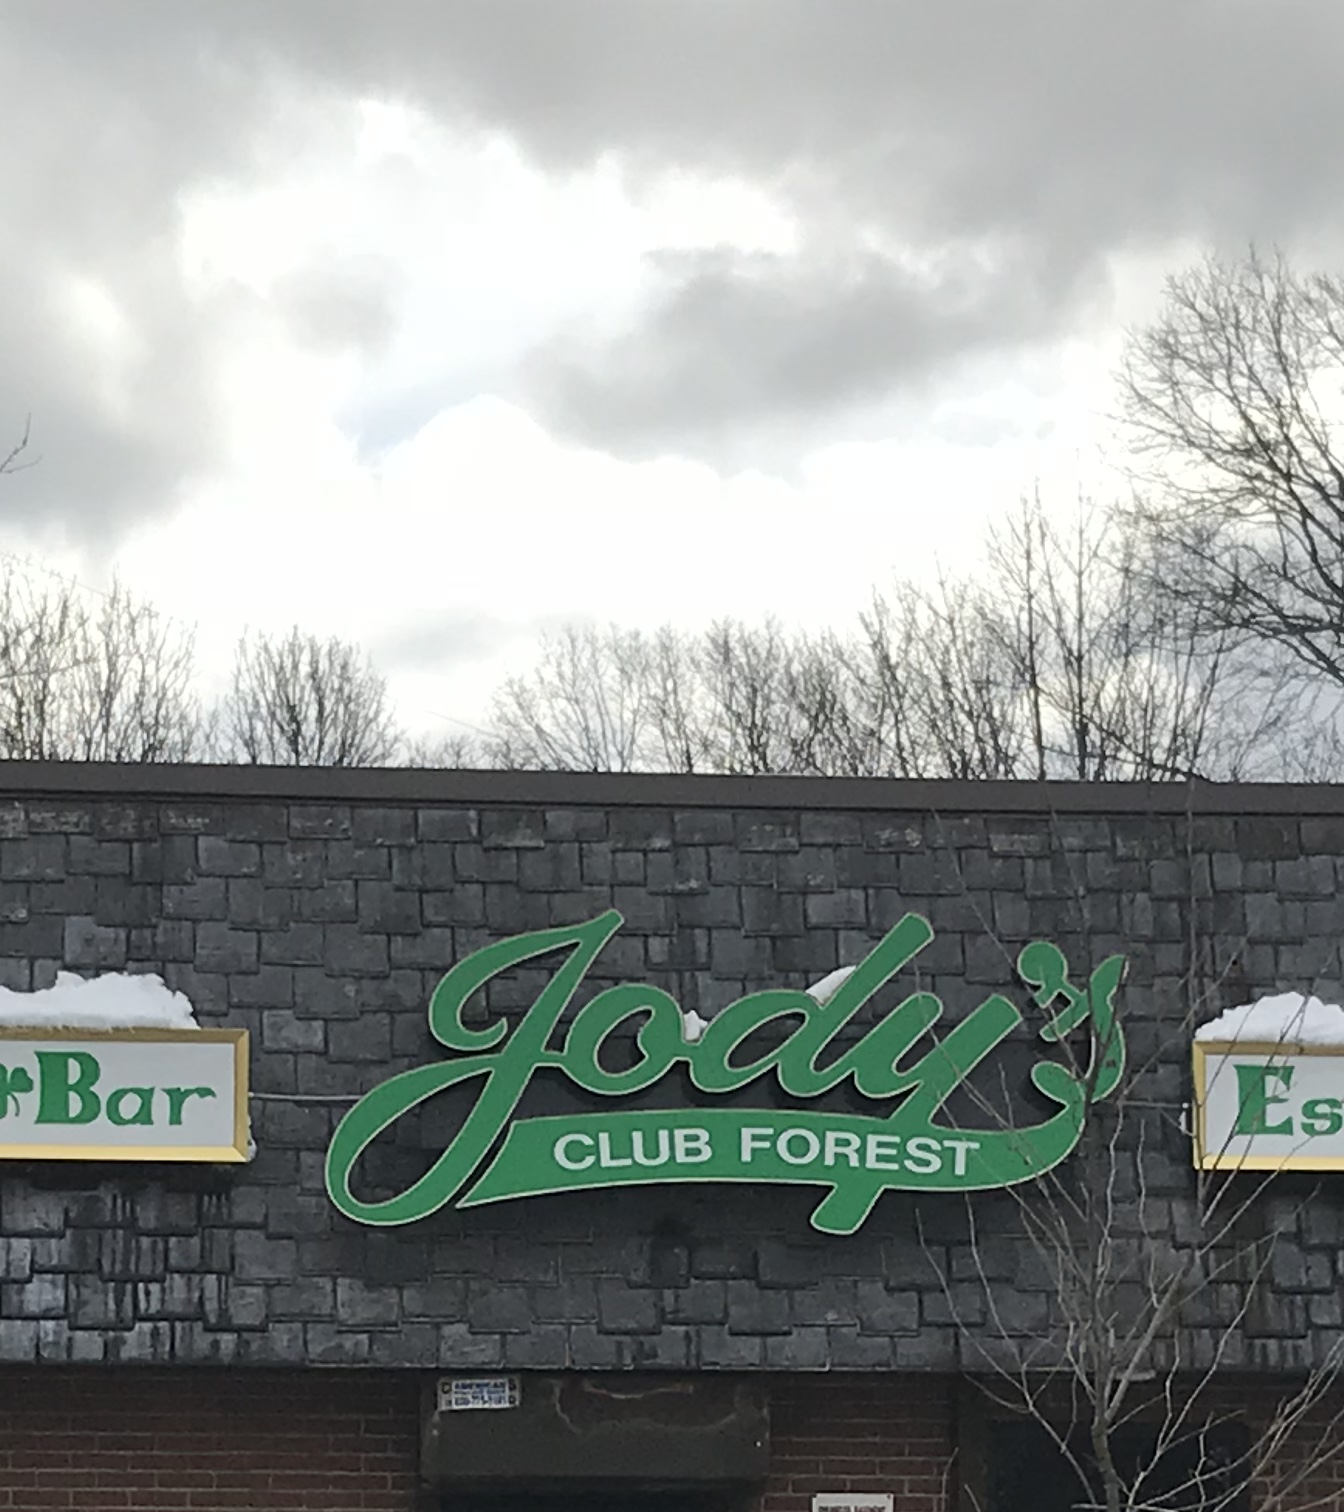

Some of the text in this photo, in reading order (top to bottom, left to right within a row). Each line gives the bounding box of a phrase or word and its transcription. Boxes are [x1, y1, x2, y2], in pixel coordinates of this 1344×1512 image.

[34, 1050, 217, 1127] Bar
[325, 910, 1129, 1236] Jody's
[553, 1126, 981, 1177] CLUB FOREST
